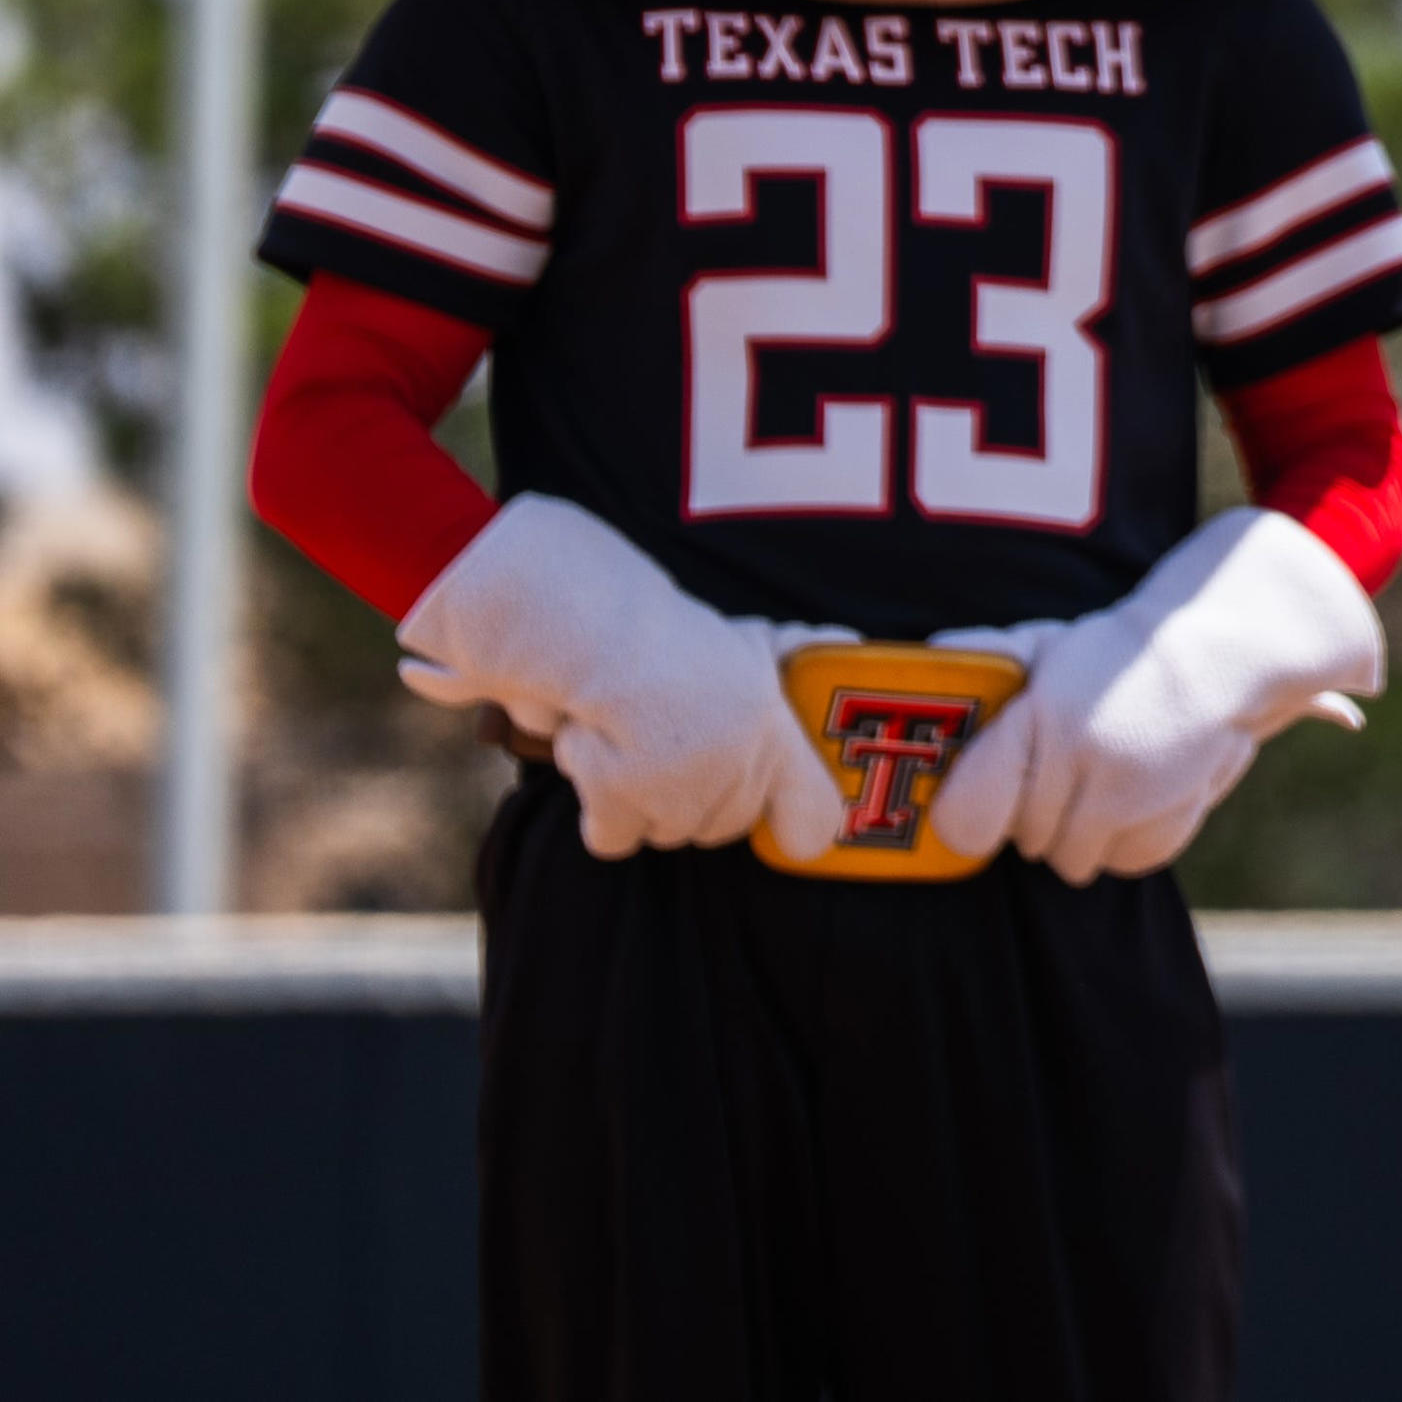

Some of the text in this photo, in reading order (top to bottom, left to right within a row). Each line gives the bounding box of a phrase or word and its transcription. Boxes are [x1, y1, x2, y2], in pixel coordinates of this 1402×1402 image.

[642, 8, 1147, 97] TEXAS TECH
[676, 102, 1120, 537] 23
